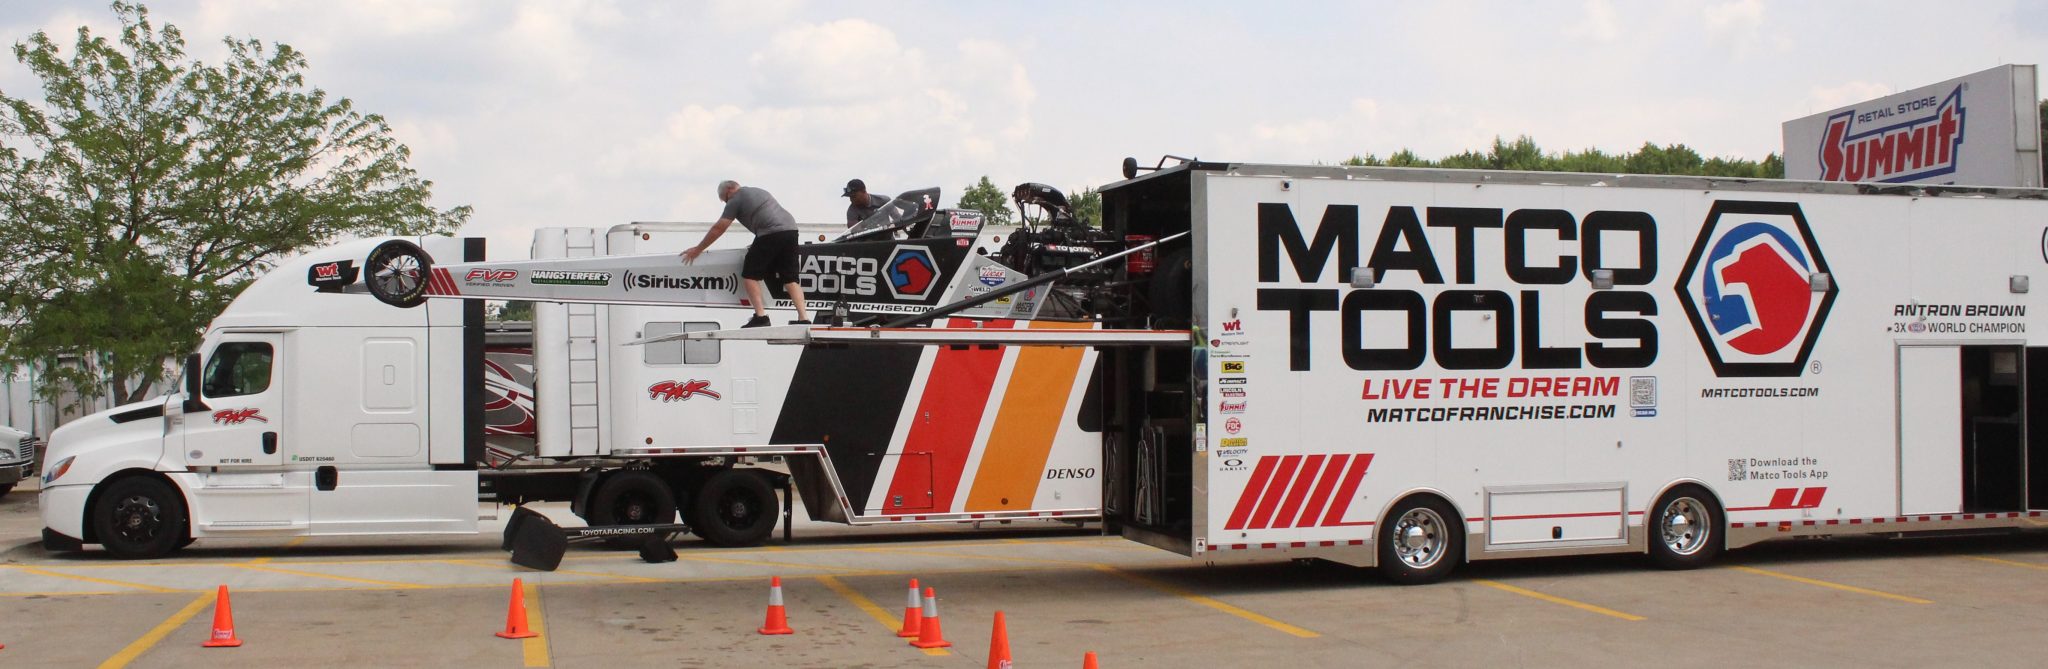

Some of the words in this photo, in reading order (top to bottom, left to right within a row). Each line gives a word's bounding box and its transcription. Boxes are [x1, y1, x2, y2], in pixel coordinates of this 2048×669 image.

[1857, 110, 1895, 124] RETAIL
[1897, 96, 1937, 114] STORE
[1823, 104, 1957, 182] SUMMIT
[1257, 202, 1658, 285] MATCO
[799, 254, 878, 276] ATCO
[465, 268, 518, 283] FVP
[531, 270, 609, 281] HANGSTERFER'S
[784, 273, 877, 296] OOLS
[1894, 304, 1961, 316] ANTRON
[1964, 304, 2026, 317] BROWN
[1222, 319, 1242, 331] wt
[1257, 288, 1659, 371] TOOLS
[1893, 322, 1906, 333] 3X
[1928, 322, 1967, 333] WORLD
[1969, 322, 2026, 333] CHAMPION
[1439, 378, 1500, 399] THE
[1507, 376, 1620, 398] DREAM
[1701, 387, 1819, 398] MATCOTOOLS.COM
[1750, 457, 1798, 467] Download
[1802, 457, 1817, 466] the
[1046, 467, 1096, 480] DENSO
[1750, 471, 1780, 480] Matco
[1782, 470, 1807, 479] Tools
[1809, 469, 1828, 480] App
[580, 527, 655, 537] TOYOTARACING.COM
